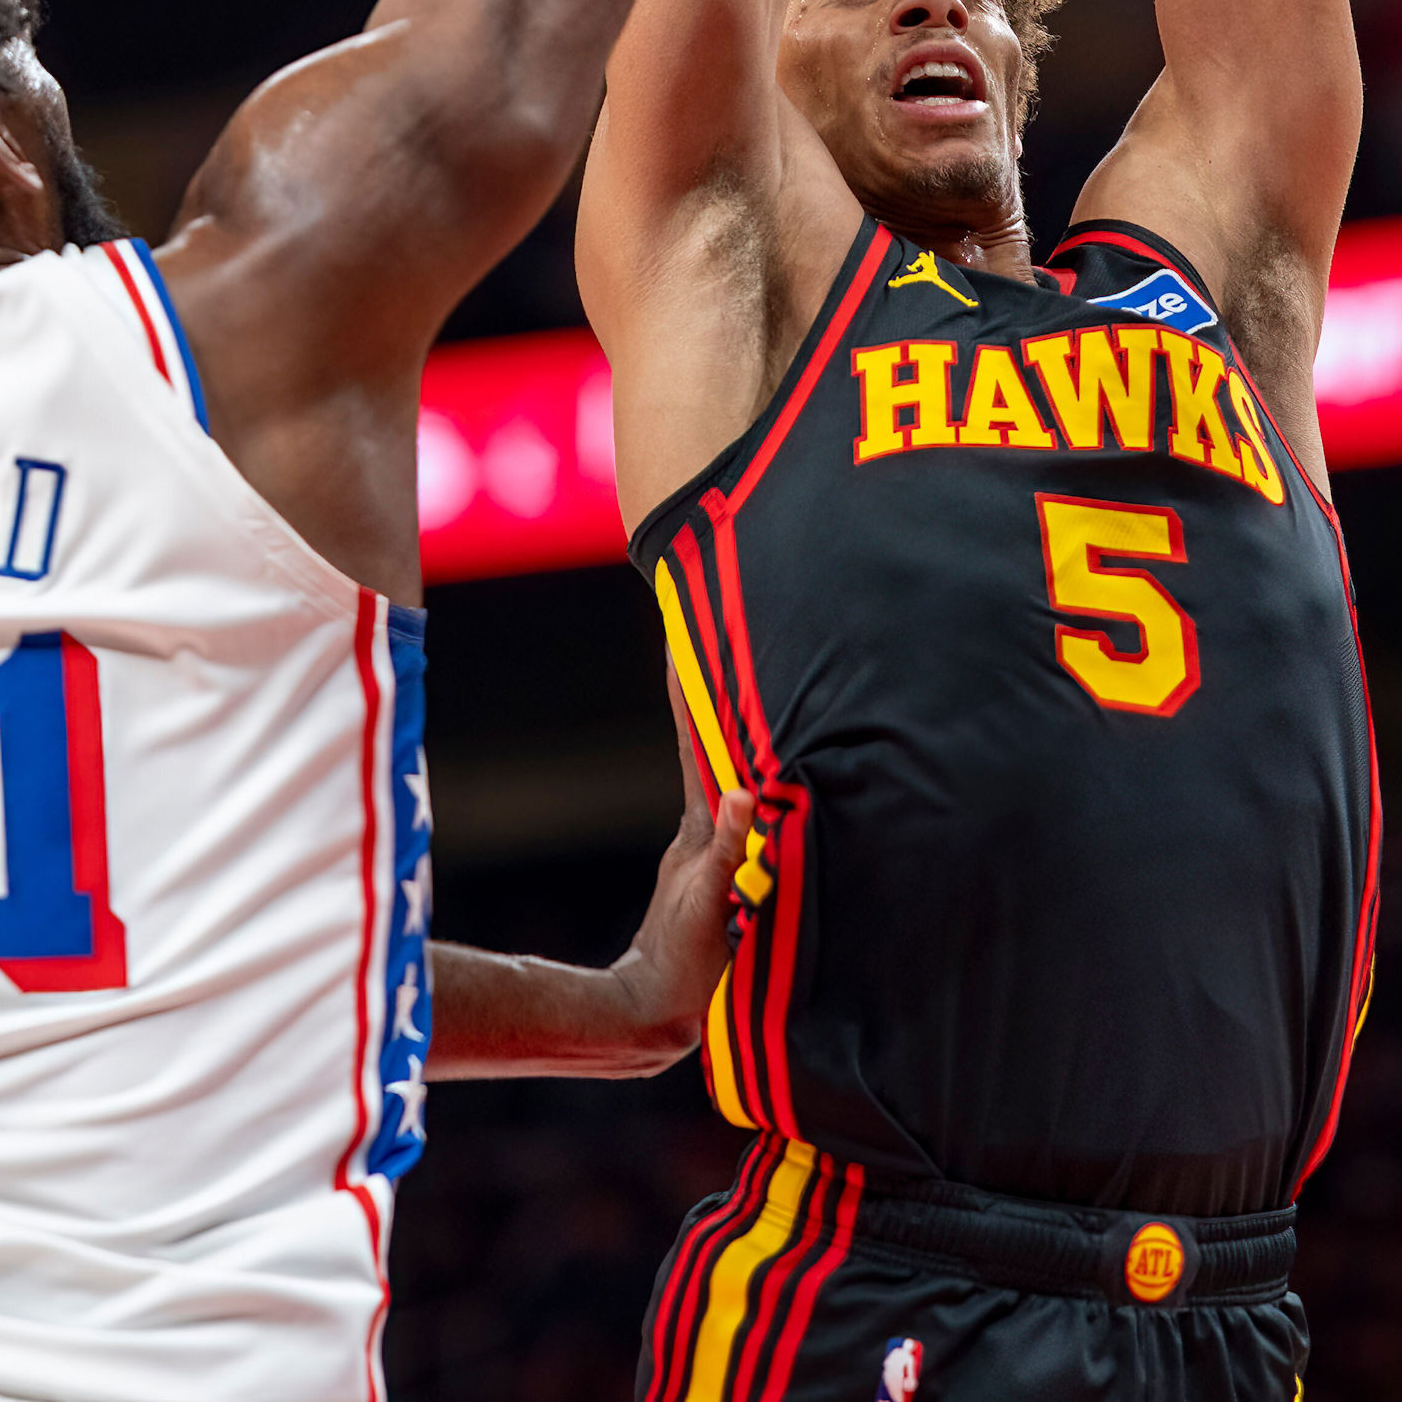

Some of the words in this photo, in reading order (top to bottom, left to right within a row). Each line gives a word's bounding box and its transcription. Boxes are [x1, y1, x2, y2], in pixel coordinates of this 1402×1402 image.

[1120, 292, 1188, 320] ze
[851, 322, 1285, 506] HAWKS
[1034, 492, 1201, 717] 5
[1134, 1246, 1174, 1278] ATL
